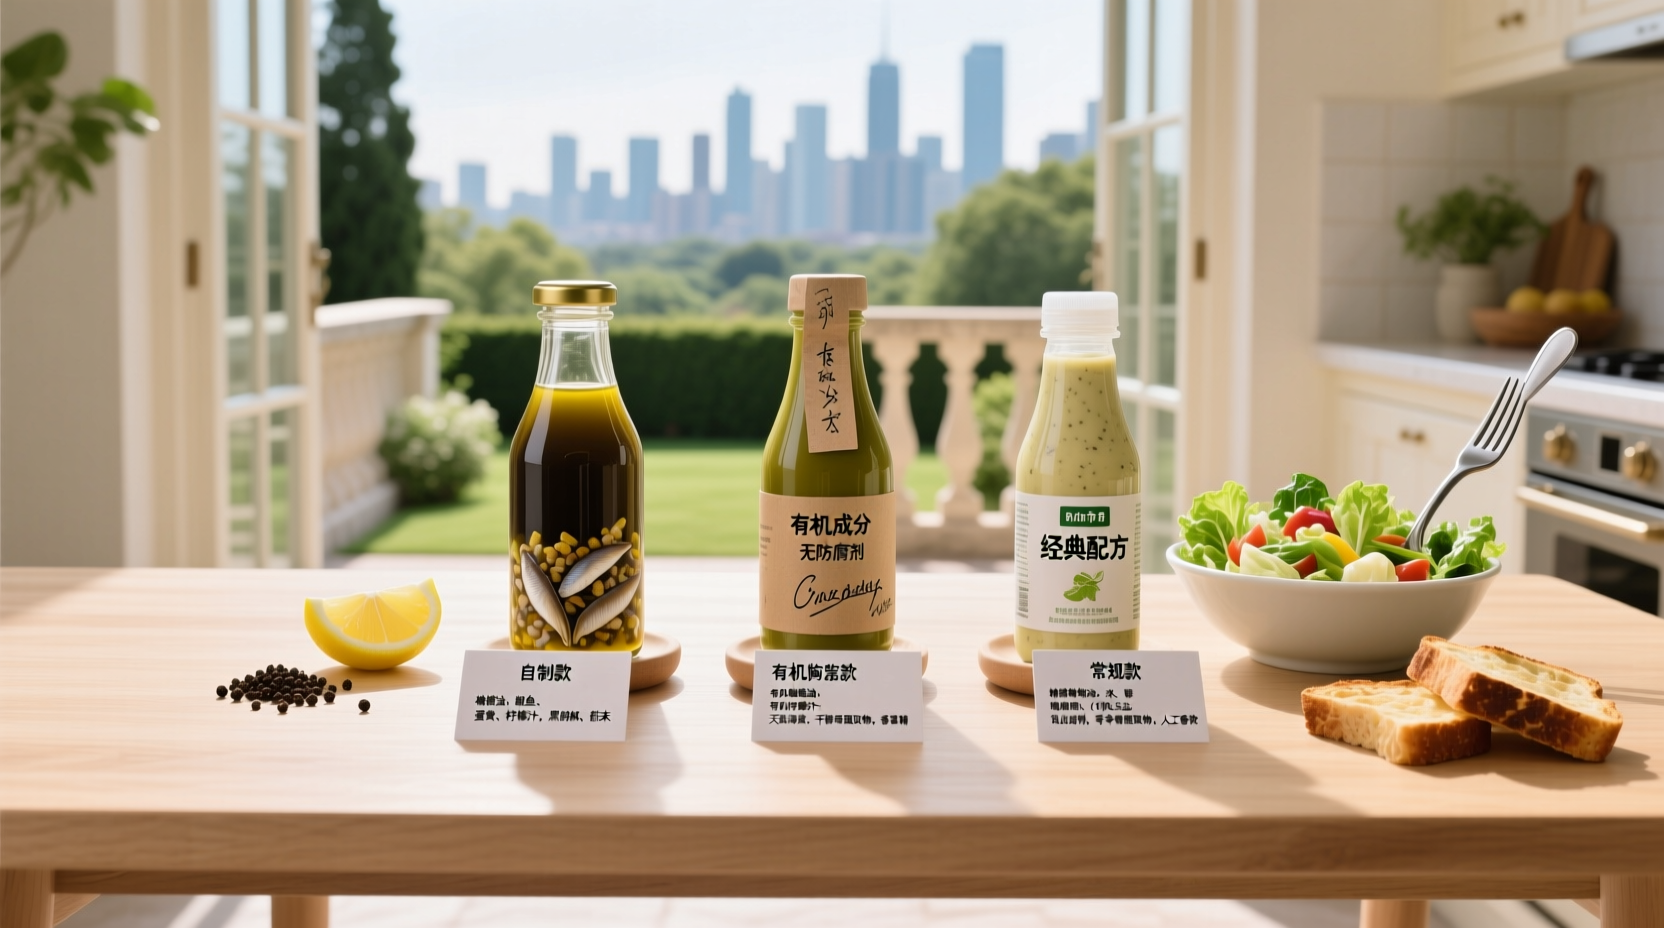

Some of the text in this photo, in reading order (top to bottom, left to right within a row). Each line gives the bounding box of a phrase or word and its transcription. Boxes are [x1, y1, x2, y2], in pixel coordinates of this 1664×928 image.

[790, 513, 872, 536] 有机成分
[1040, 534, 1129, 560] 经典配方
[521, 663, 572, 682] 自制款
[1090, 662, 1141, 680] 常规款
